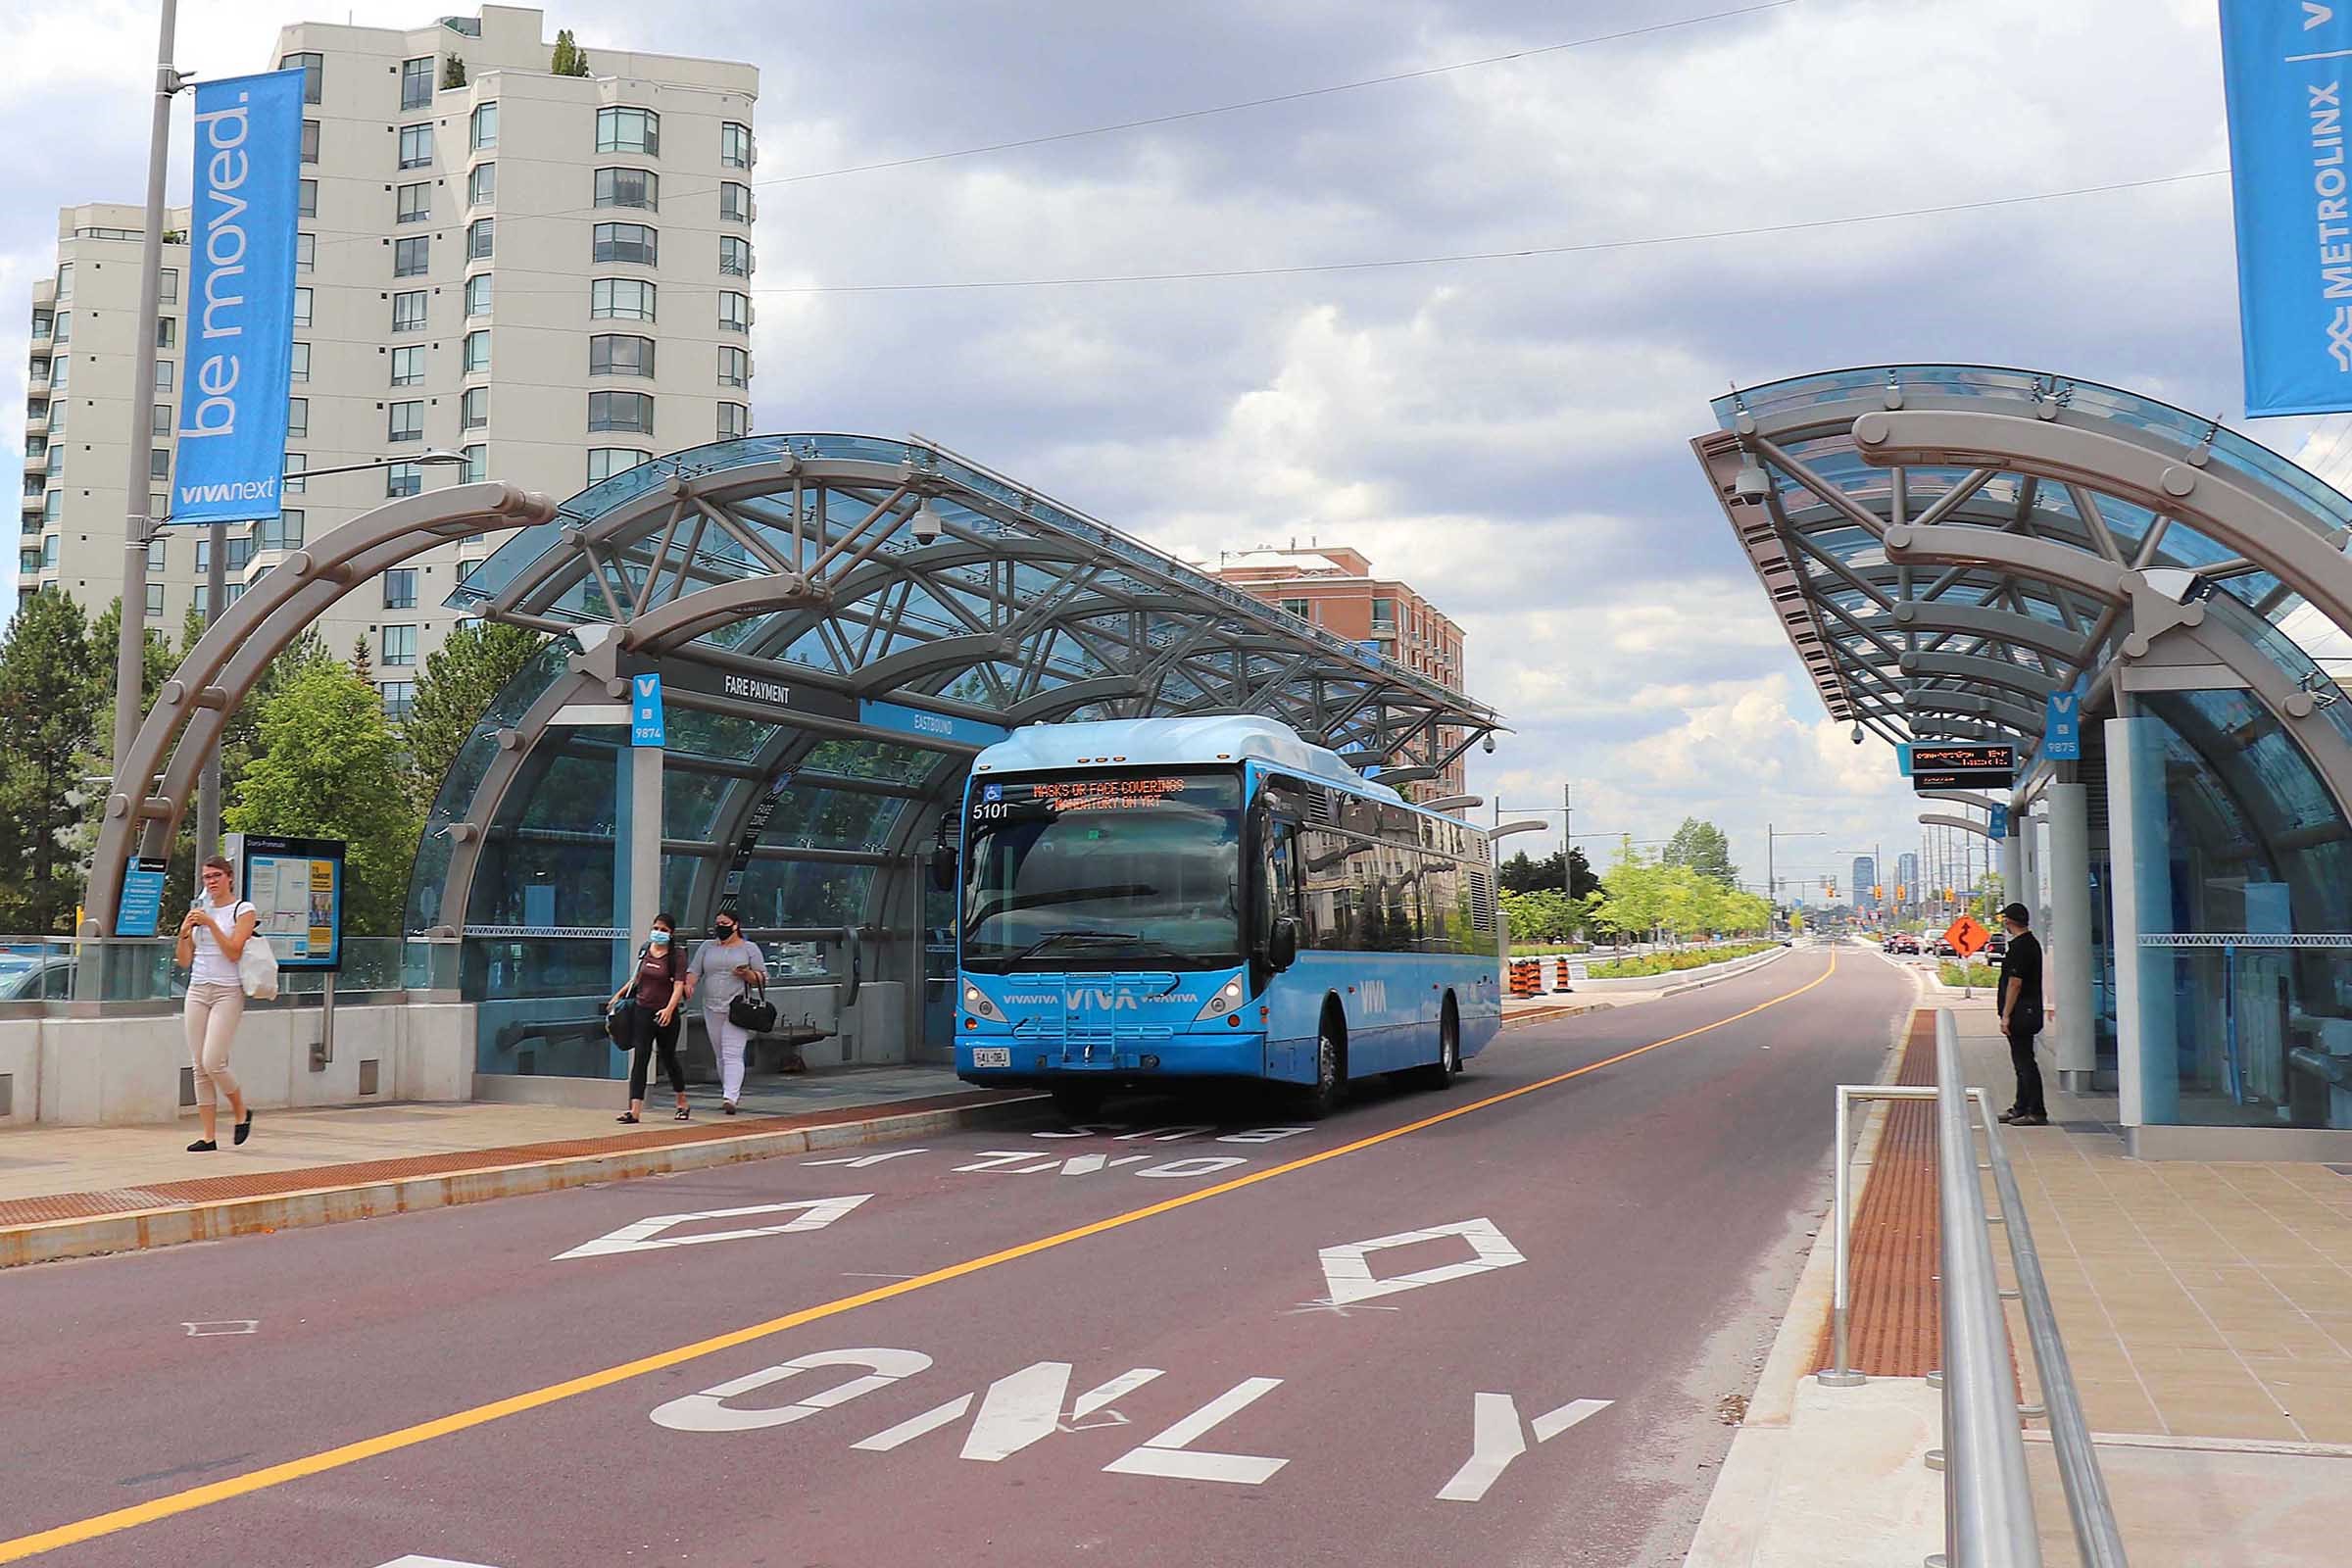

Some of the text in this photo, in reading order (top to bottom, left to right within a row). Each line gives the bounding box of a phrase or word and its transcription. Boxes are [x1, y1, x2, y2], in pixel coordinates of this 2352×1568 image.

[2308, 80, 2352, 298] METROLINX
[178, 92, 248, 438] be moved.
[725, 674, 790, 704] FARE PAYMENT
[636, 728, 662, 738] 9874
[913, 713, 954, 735] EASTBOUND
[2047, 743, 2077, 753] 9875
[1033, 779, 1185, 798] MASKS OR FACE COVERINGS
[972, 804, 1007, 819] 5101
[1141, 795, 1161, 807] YRT
[1003, 995, 1058, 1004] VIVAVIVA
[1066, 989, 1138, 1010] VIVA
[1360, 980, 1387, 1014] VIVA
[649, 1348, 1615, 1501] ONLY
